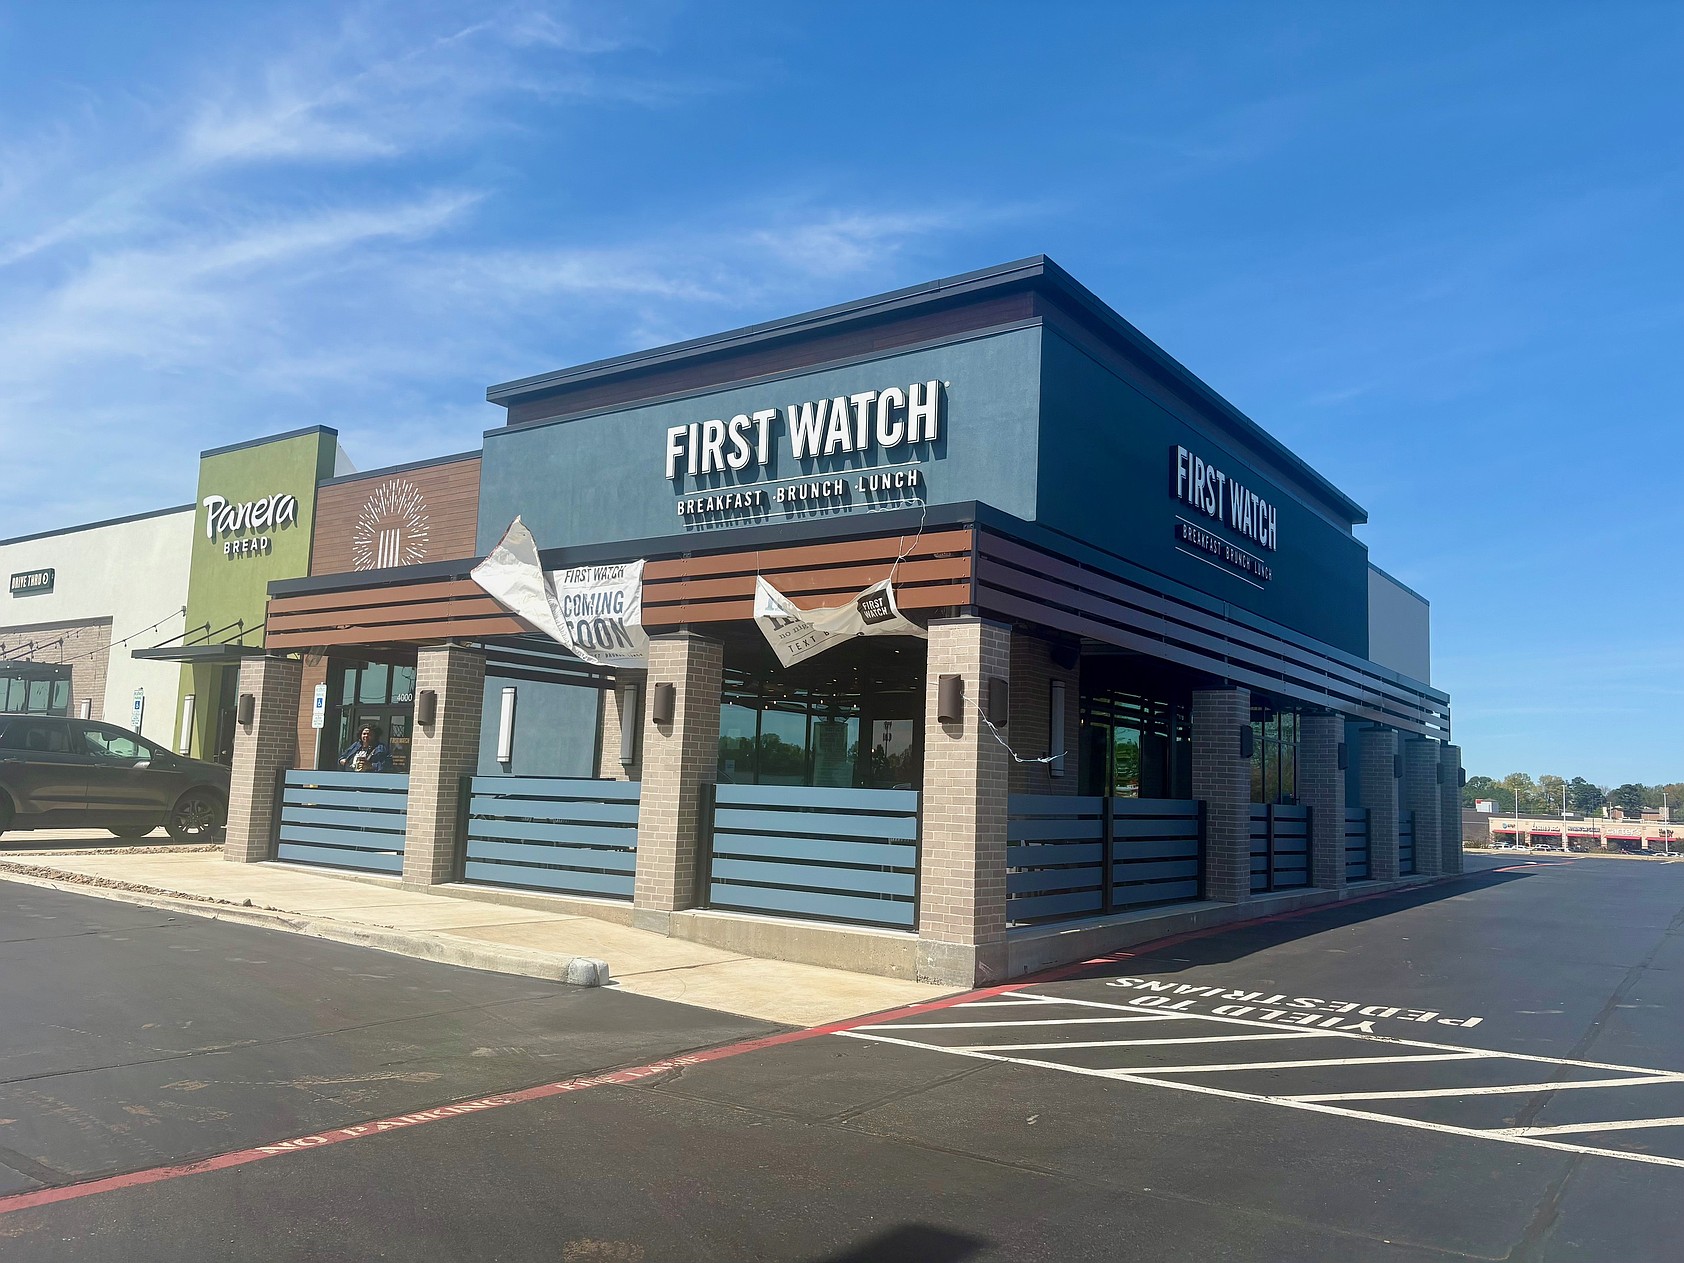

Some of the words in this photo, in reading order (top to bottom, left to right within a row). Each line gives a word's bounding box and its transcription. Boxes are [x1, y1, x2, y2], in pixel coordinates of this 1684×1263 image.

[665, 408, 778, 480] FIRST
[787, 379, 940, 460] WATCH
[677, 490, 762, 516] BREAKFAST
[776, 479, 843, 503] BRUNCH
[858, 469, 918, 492] LUNCH
[1177, 444, 1226, 522] FIRST
[1229, 478, 1277, 552] WATCH
[202, 493, 295, 539] Panera
[223, 536, 268, 554] BREAD
[1182, 523, 1222, 555] BREAKFAST
[1225, 546, 1251, 571] BRUNCH
[564, 568, 592, 583] FIRST
[593, 565, 626, 581] WATCH
[564, 590, 624, 617] COMING
[862, 597, 884, 610] FIRST
[863, 606, 888, 619] WATCH
[788, 635, 817, 653] TEXT
[397, 693, 413, 702] 4000
[1105, 977, 1484, 1028] PEDESTRIANS
[1128, 995, 1197, 1011] TO
[1211, 1004, 1376, 1034] YIELD
[254, 1136, 328, 1154] NO
[341, 1098, 511, 1137] PARKING
